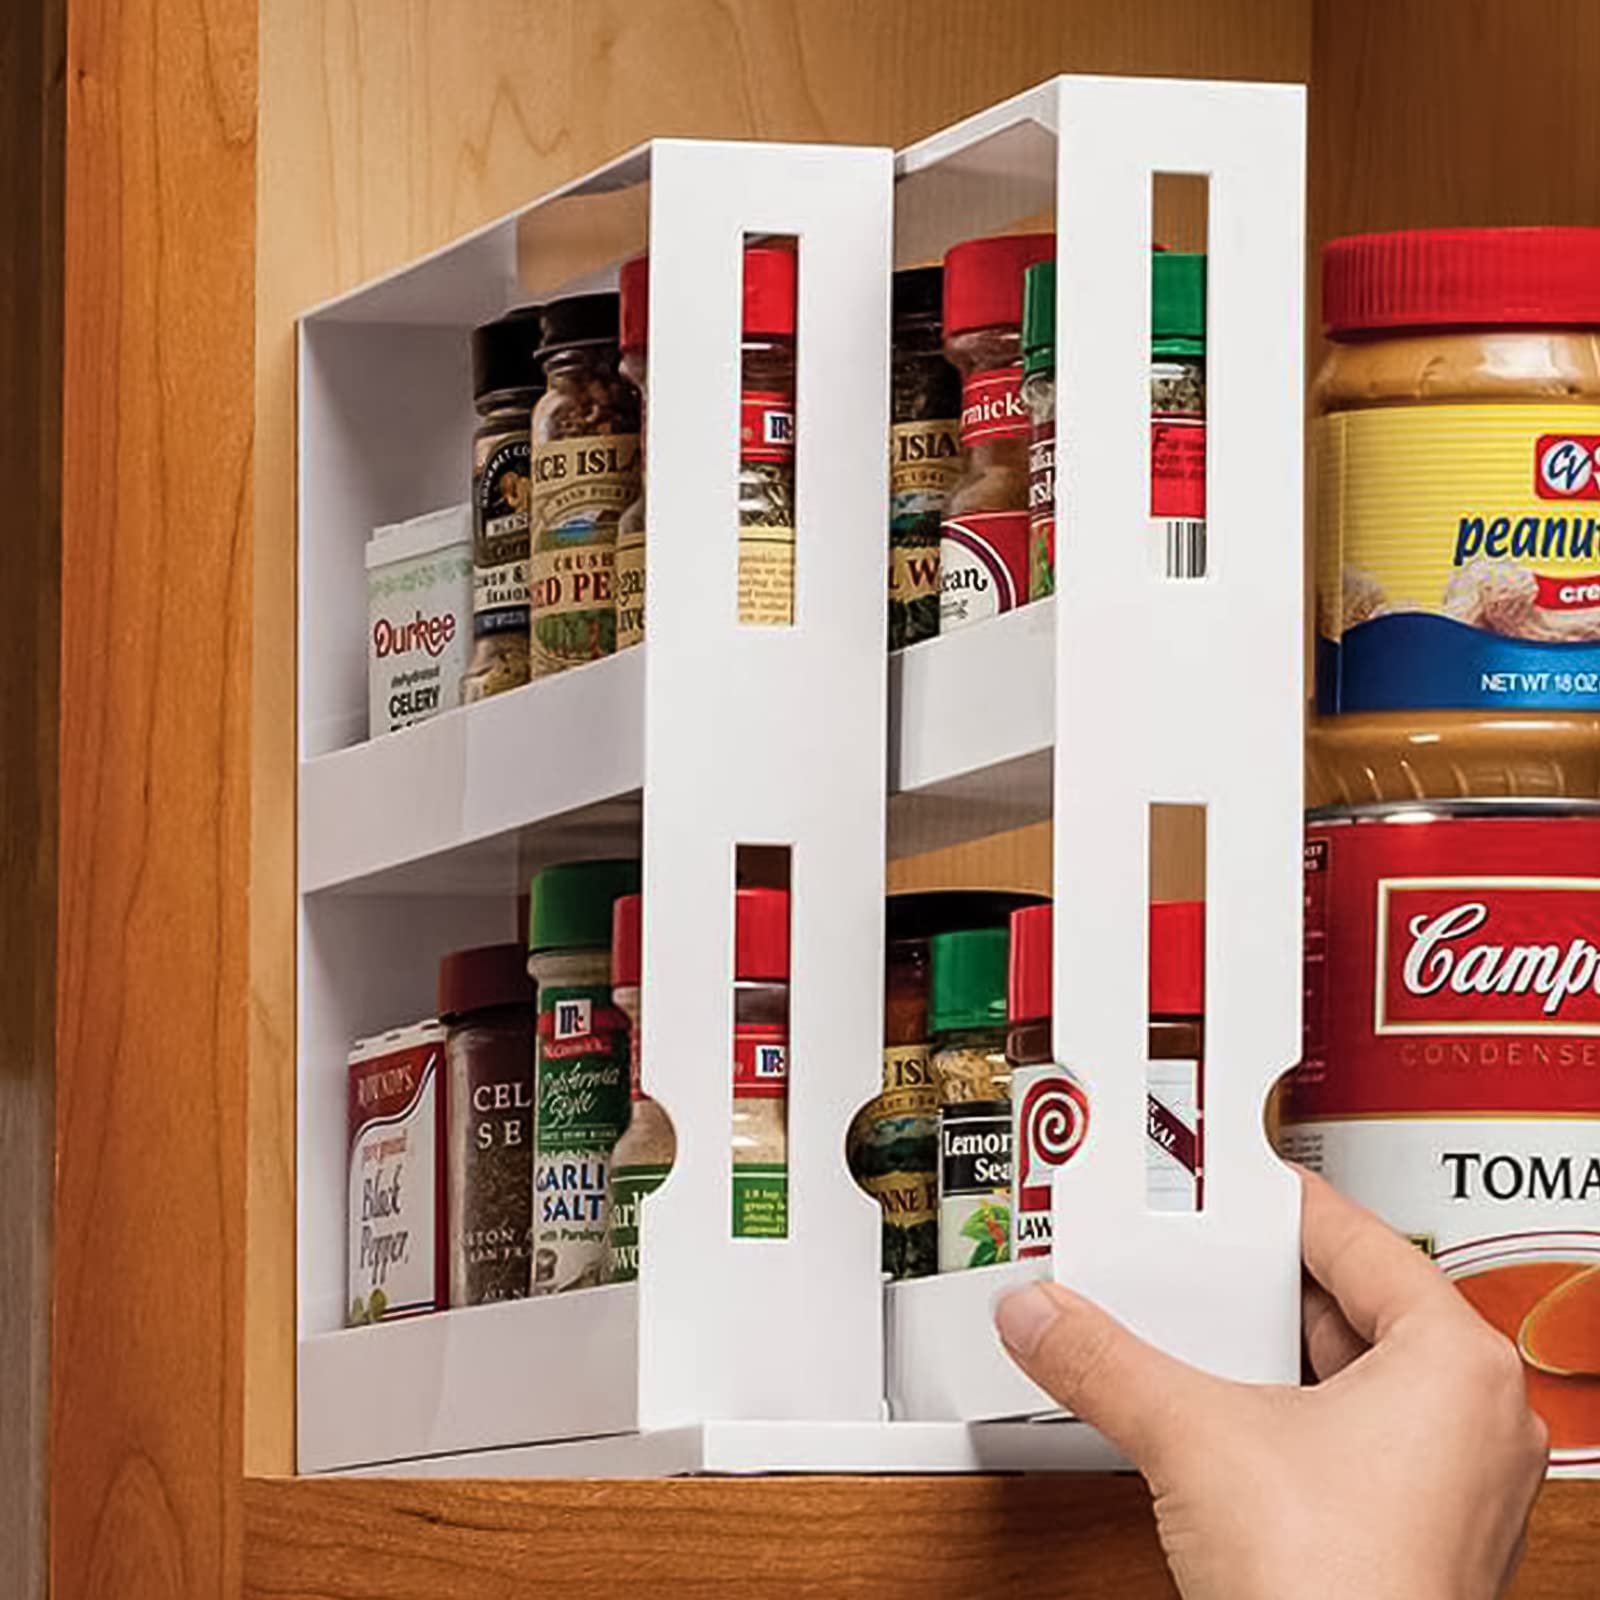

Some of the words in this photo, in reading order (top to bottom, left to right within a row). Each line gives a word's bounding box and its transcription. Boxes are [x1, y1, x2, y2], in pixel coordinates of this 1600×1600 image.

[374, 611, 456, 658] Durkee
[389, 684, 440, 719] CELERY
[473, 1082, 531, 1113] CEL
[543, 1194, 605, 1223] SALT
